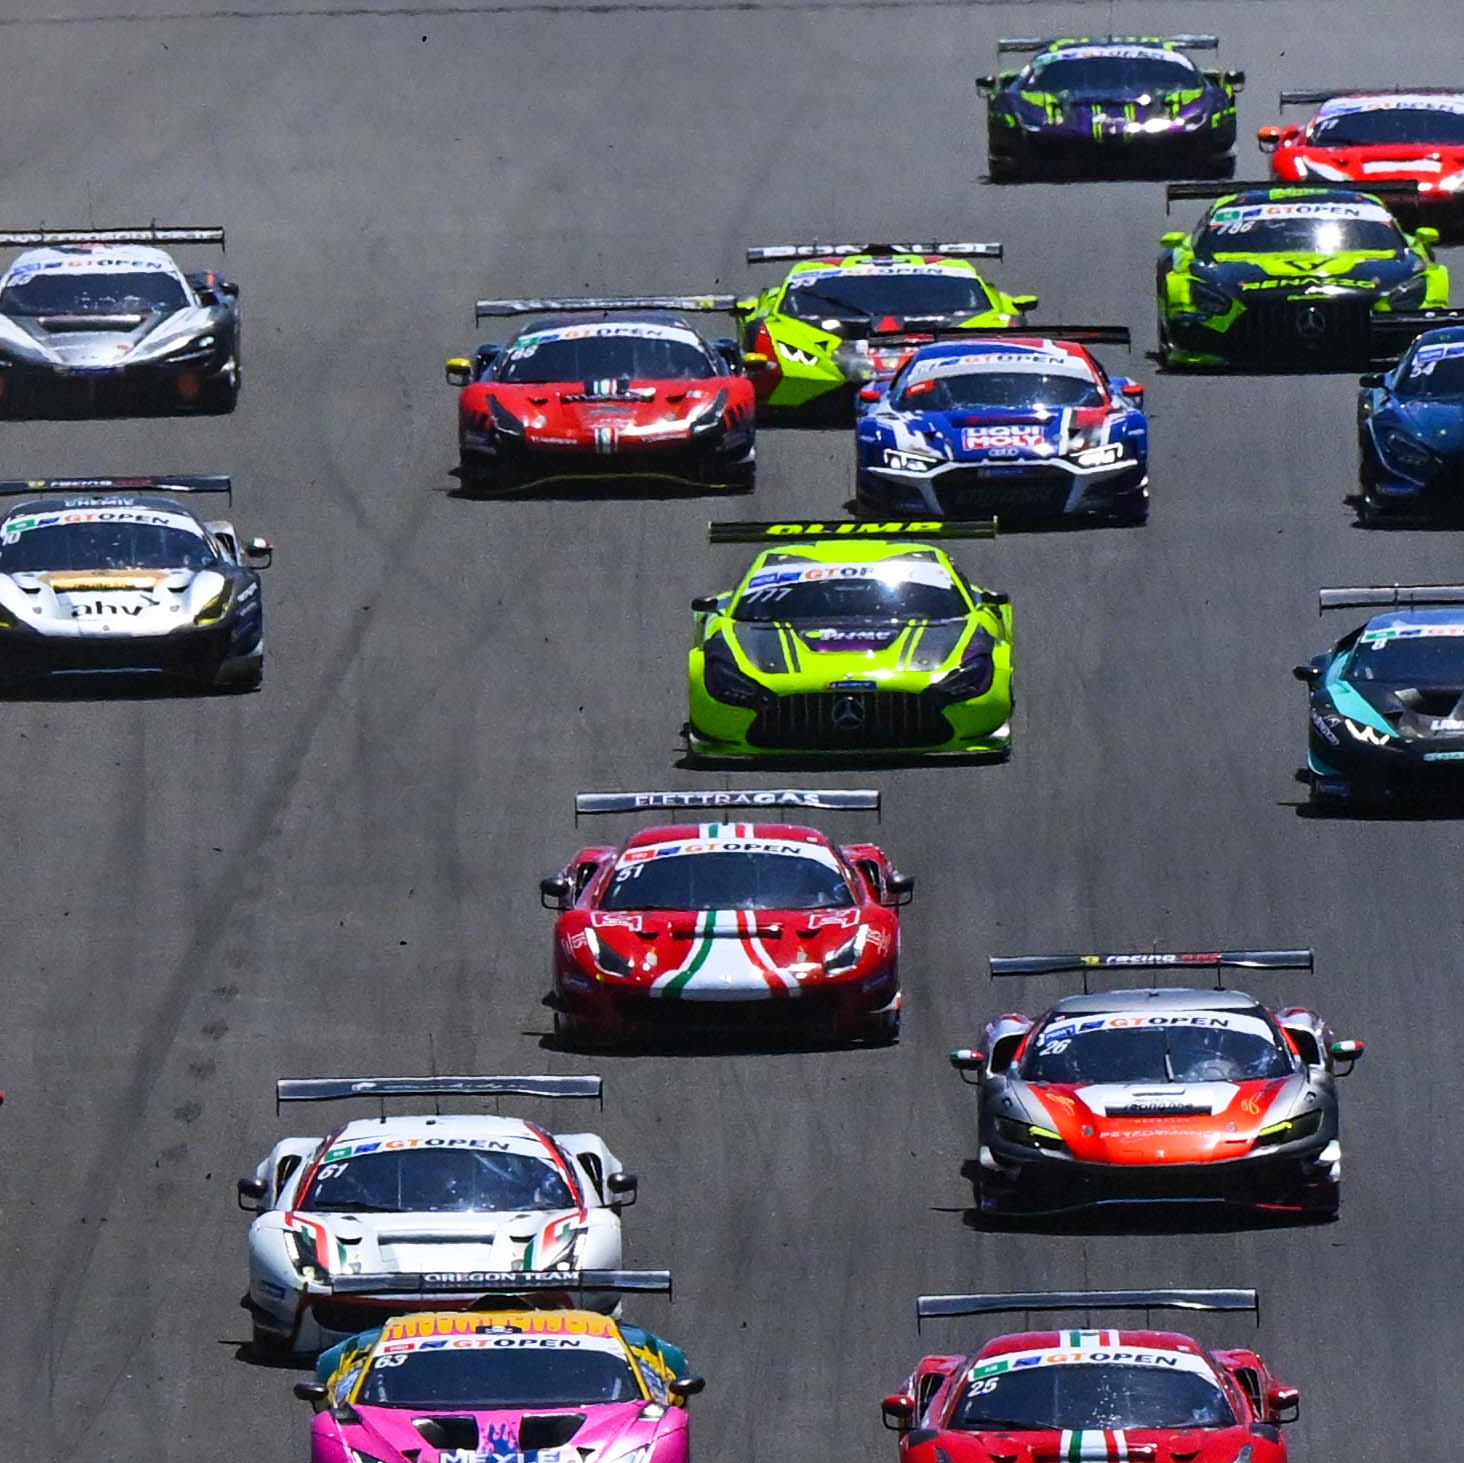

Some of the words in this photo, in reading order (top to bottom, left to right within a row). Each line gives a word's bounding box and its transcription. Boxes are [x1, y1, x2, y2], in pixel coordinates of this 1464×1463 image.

[64, 513, 170, 526] GTOPEN
[766, 522, 943, 535] OLIMP
[635, 793, 820, 806] ELETTRAGAS
[686, 842, 802, 855] GTOPEN
[615, 865, 644, 883] 51
[1109, 1016, 1229, 1029] GTOPEN
[1040, 1039, 1070, 1057] 26
[385, 1138, 510, 1151] GTOPEN
[317, 1163, 349, 1181] 61
[424, 1272, 516, 1284] OREGON
[523, 1271, 579, 1282] TEAM
[453, 1338, 582, 1349] GTOPEN
[373, 1354, 408, 1369] 63
[1046, 1352, 1179, 1367] GTOPEN
[967, 1379, 999, 1398] 25
